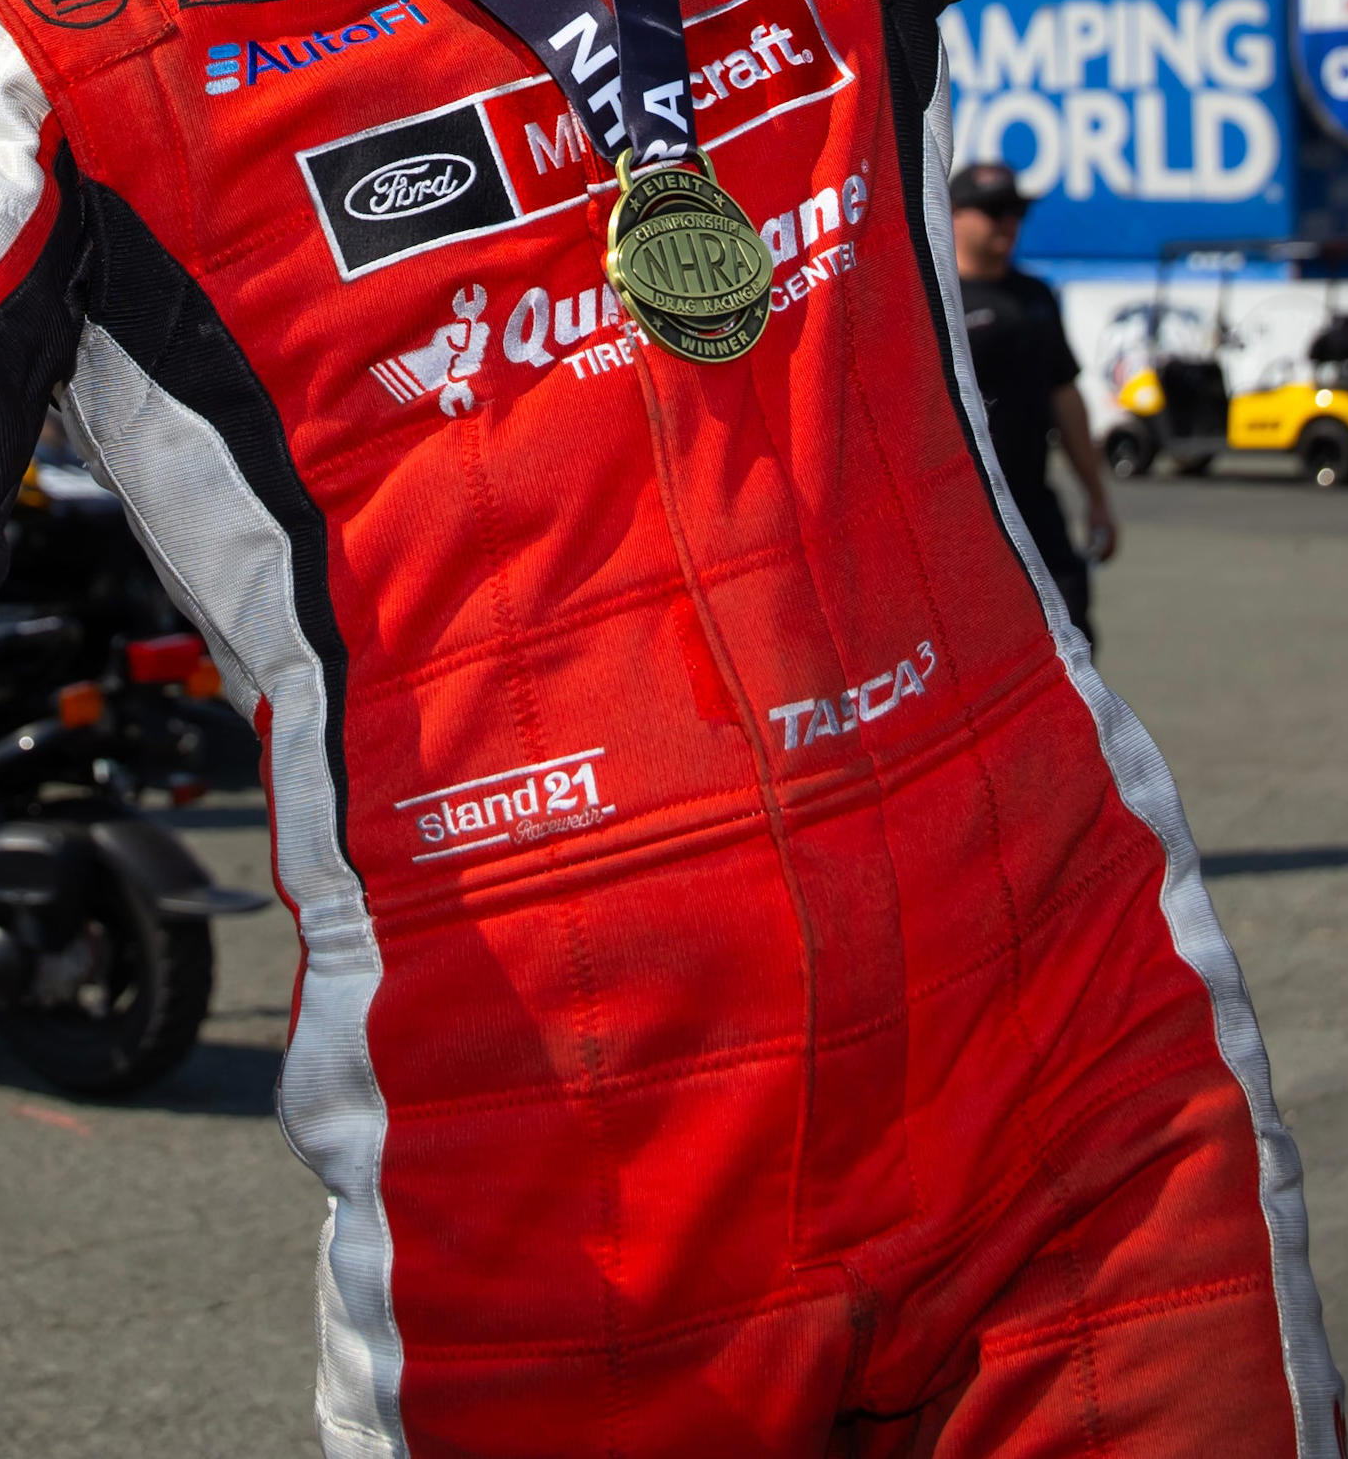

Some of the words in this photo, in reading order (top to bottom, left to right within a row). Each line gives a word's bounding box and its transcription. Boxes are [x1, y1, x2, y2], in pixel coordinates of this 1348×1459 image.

[952, 88, 1282, 204] ORLD
[369, 163, 459, 214] Ford
[642, 174, 704, 198] EVENT
[634, 215, 737, 242] CHAMPIONSHIP
[759, 174, 868, 269] ane
[642, 230, 753, 293] NHRA
[654, 291, 696, 313] DRAG
[703, 288, 755, 314] RACING
[679, 329, 751, 356] WINNER
[416, 776, 539, 843] stand
[543, 762, 600, 816] 21
